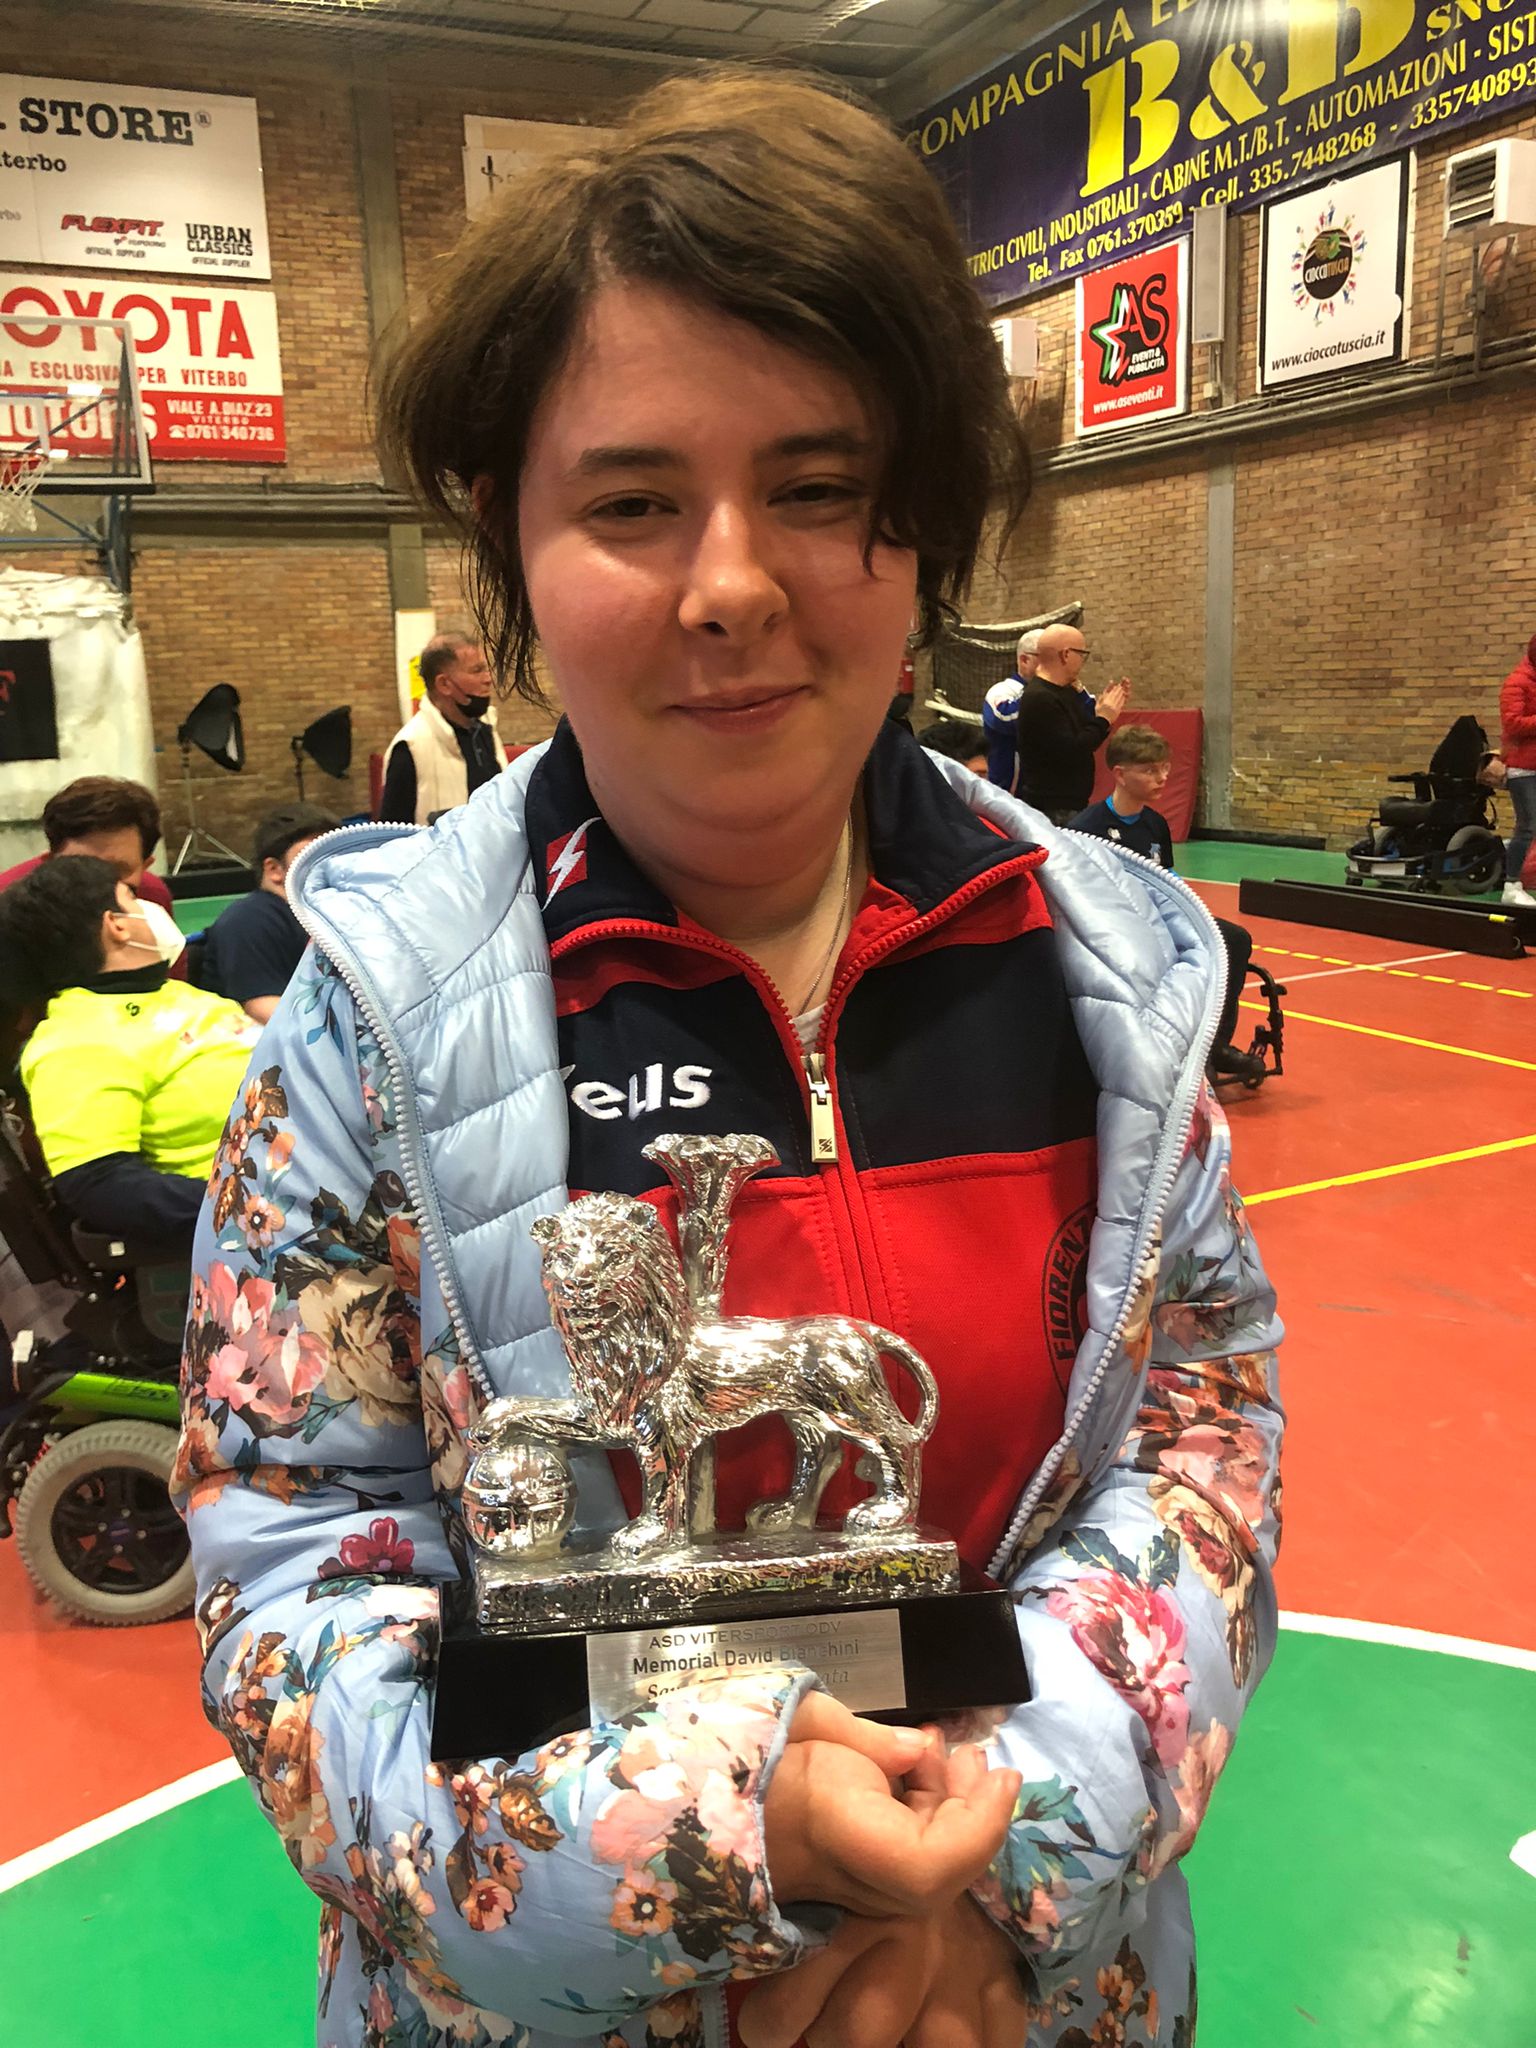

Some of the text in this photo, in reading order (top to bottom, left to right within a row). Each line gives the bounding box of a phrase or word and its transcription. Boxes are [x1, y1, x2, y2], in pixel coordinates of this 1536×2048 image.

[1080, 0, 1416, 197] B&B
[1050, 183, 1140, 246] INDUSTRIALI
[1151, 149, 1211, 201] CABINE
[1306, 38, 1466, 136] AUTOMAZIONI
[1488, 10, 1536, 61] SIST
[0, 151, 67, 172] terbo
[1027, 256, 1053, 283] Tel.
[1060, 246, 1084, 272] Fax
[1087, 200, 1184, 260] 0761.370359
[1201, 175, 1244, 208] Cell.
[1249, 121, 1377, 193] 335.7448268
[1409, 56, 1536, 130] 335740893
[60, 213, 164, 237] FLEXFIT
[185, 223, 252, 244] URBAN
[187, 239, 254, 257] CLASSICS
[0, 286, 255, 360] OYOTA
[1271, 330, 1386, 371] www.cioccotuscia.it
[138, 367, 167, 384] PER
[181, 368, 248, 388] VITERBO
[166, 399, 204, 415] VIALE
[1093, 385, 1164, 414] www.aseventi.it
[191, 415, 250, 425] VITERBO
[560, 1063, 713, 1121] eus
[1048, 1214, 1090, 1361] FIORENZ
[649, 1620, 842, 1649] ASD VITERSPORT ODV
[633, 1639, 860, 1675] Memorial David Bianchini
